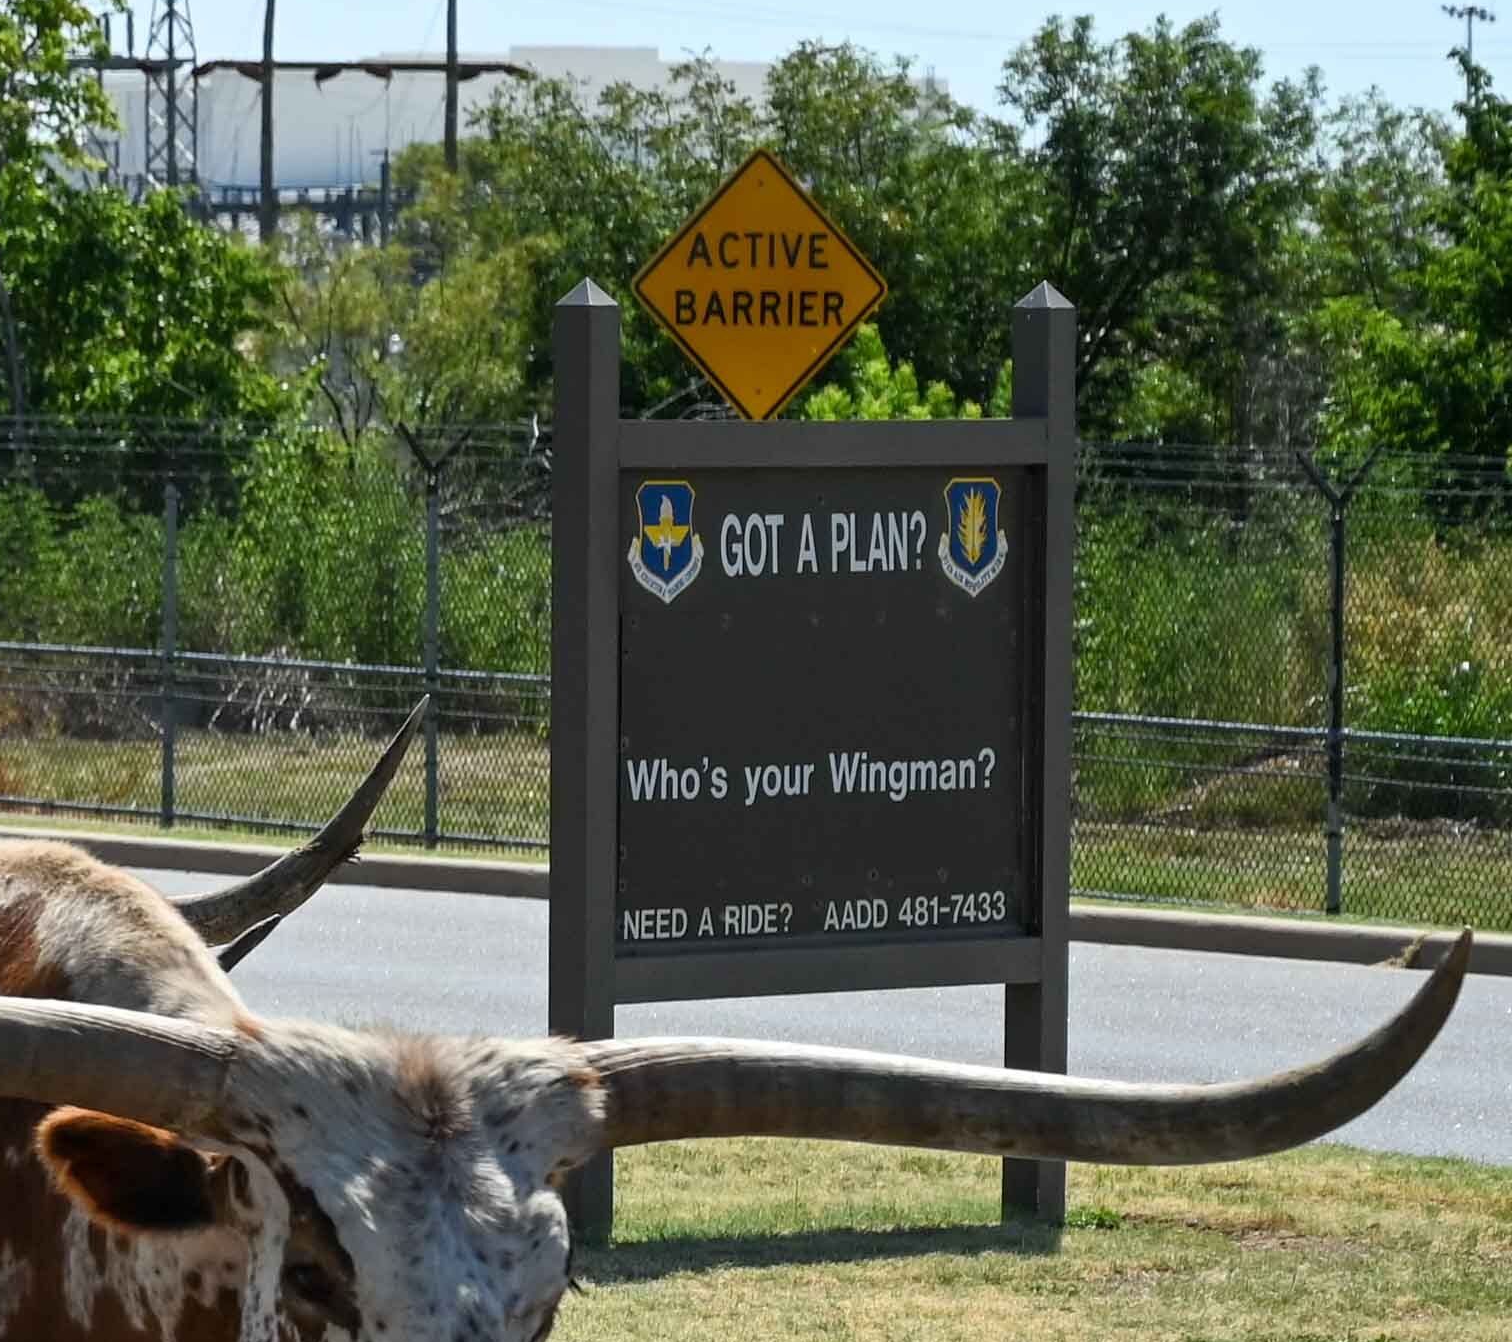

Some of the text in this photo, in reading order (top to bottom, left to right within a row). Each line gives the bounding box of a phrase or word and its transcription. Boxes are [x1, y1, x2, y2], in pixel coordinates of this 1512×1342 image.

[687, 232, 829, 270] ACTIVE
[673, 289, 845, 328] BARRIER
[721, 514, 783, 576] GOT
[797, 514, 817, 573] A
[832, 511, 926, 572] PLAN?
[745, 764, 814, 805] your
[829, 748, 995, 801] Wingman?
[624, 891, 1005, 939] NEED A RIDE? AADD 481-7433
